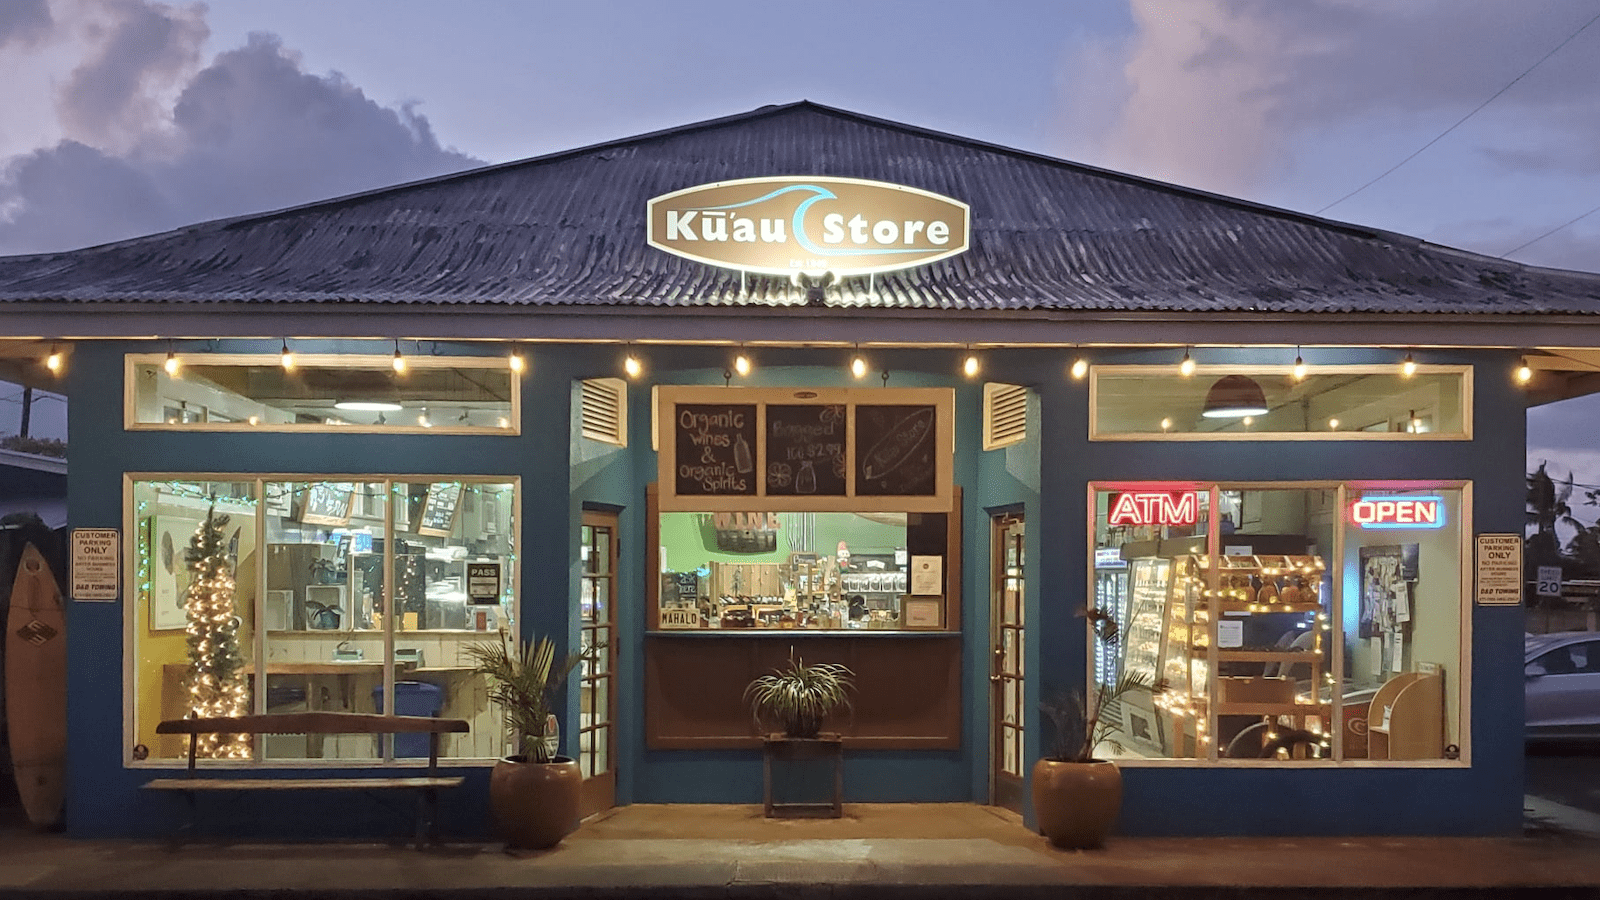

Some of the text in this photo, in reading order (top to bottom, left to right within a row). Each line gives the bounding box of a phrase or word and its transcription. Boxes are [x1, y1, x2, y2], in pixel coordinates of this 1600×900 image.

[823, 213, 950, 245] Store
[680, 409, 745, 435] Organic
[701, 446, 717, 464] &
[1110, 493, 1194, 524] ATM
[1353, 501, 1436, 523] OPEN
[713, 511, 781, 530] WINE
[83, 546, 108, 554] ONLY
[1488, 551, 1511, 559] ONLY
[471, 568, 496, 576] PASS
[1539, 581, 1559, 593] 20
[661, 612, 697, 625] MAHALO
